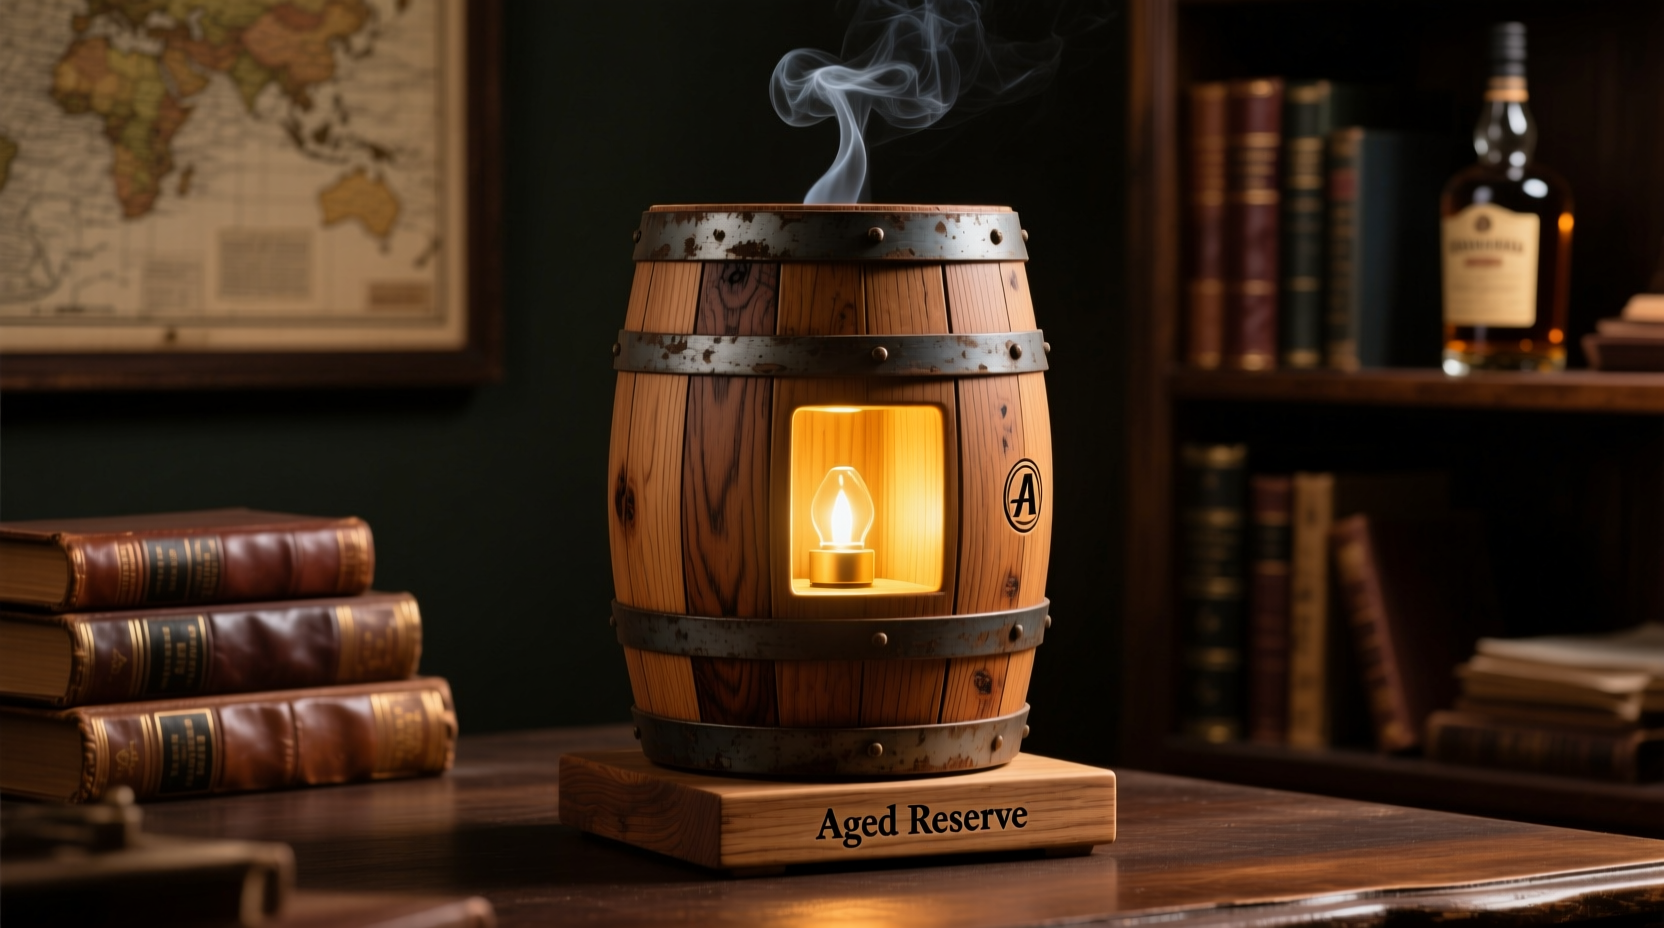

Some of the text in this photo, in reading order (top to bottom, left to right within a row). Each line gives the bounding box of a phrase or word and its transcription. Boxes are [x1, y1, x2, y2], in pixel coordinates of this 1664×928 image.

[1010, 473, 1036, 517] A
[816, 803, 1028, 848] Aged Reserve
